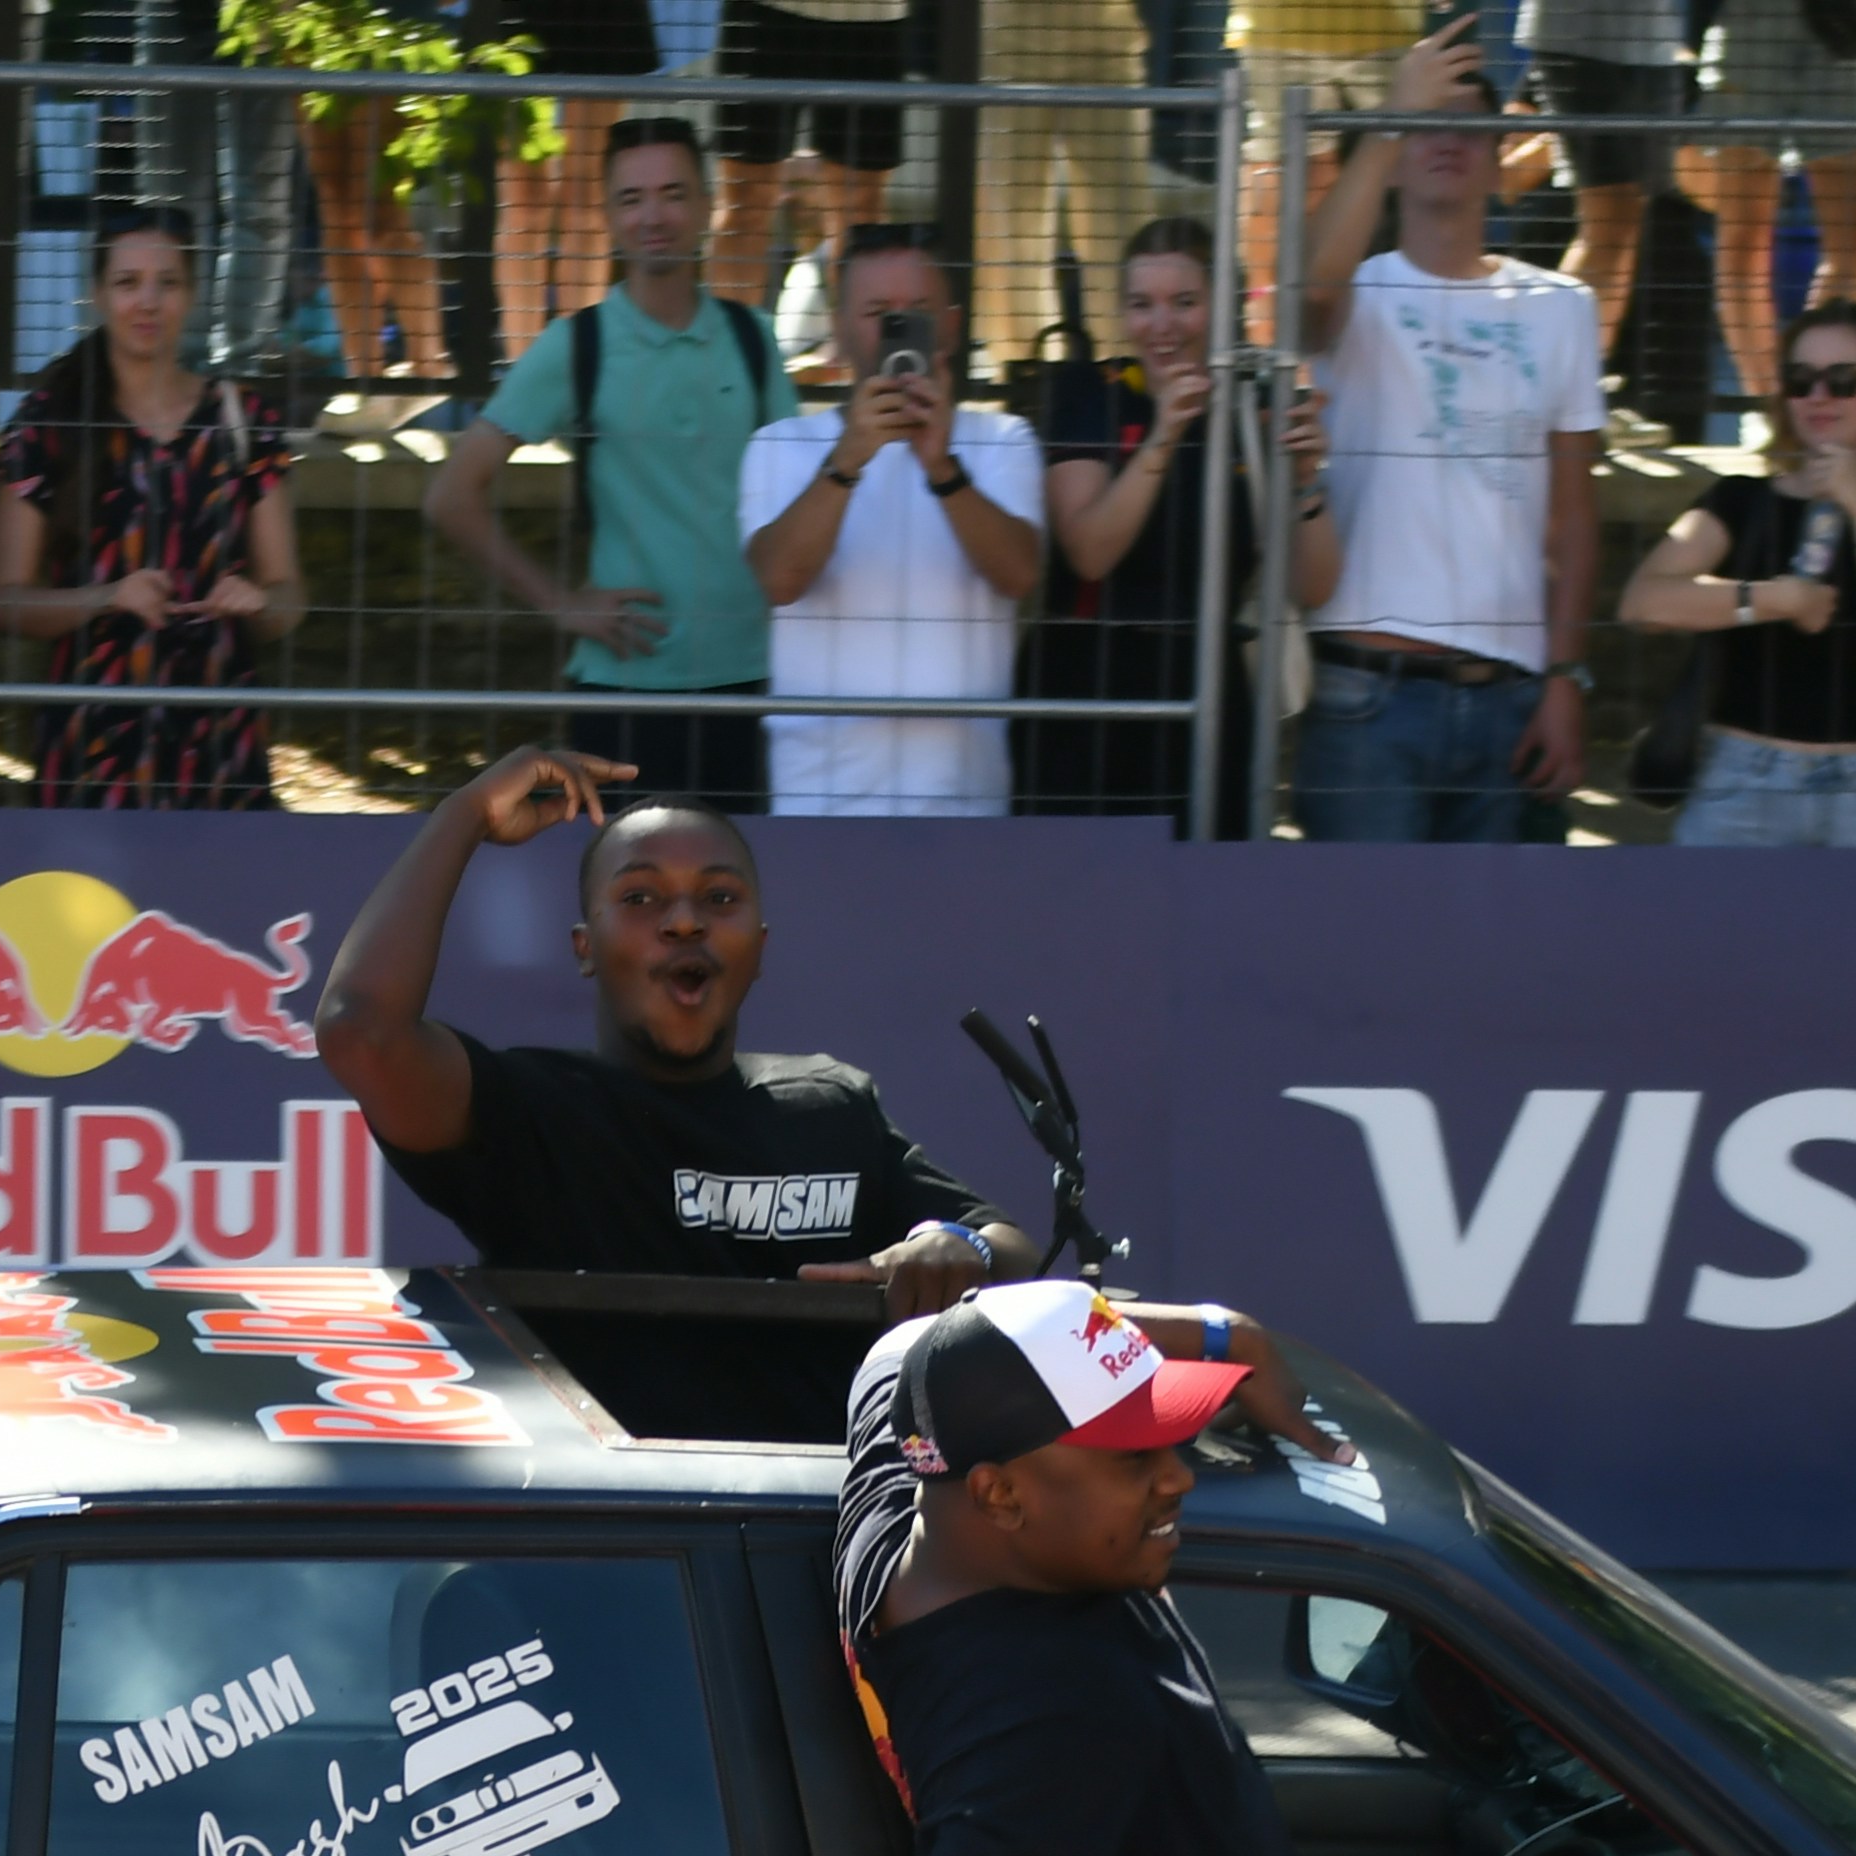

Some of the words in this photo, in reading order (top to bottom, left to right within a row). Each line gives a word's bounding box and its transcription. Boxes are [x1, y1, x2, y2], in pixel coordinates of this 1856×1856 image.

[64, 1100, 384, 1267] Bull
[204, 1340, 522, 1444] Red
[1099, 1331, 1142, 1380] Red
[80, 1654, 316, 1804] SAMSAM
[390, 1638, 554, 1737] 2025
